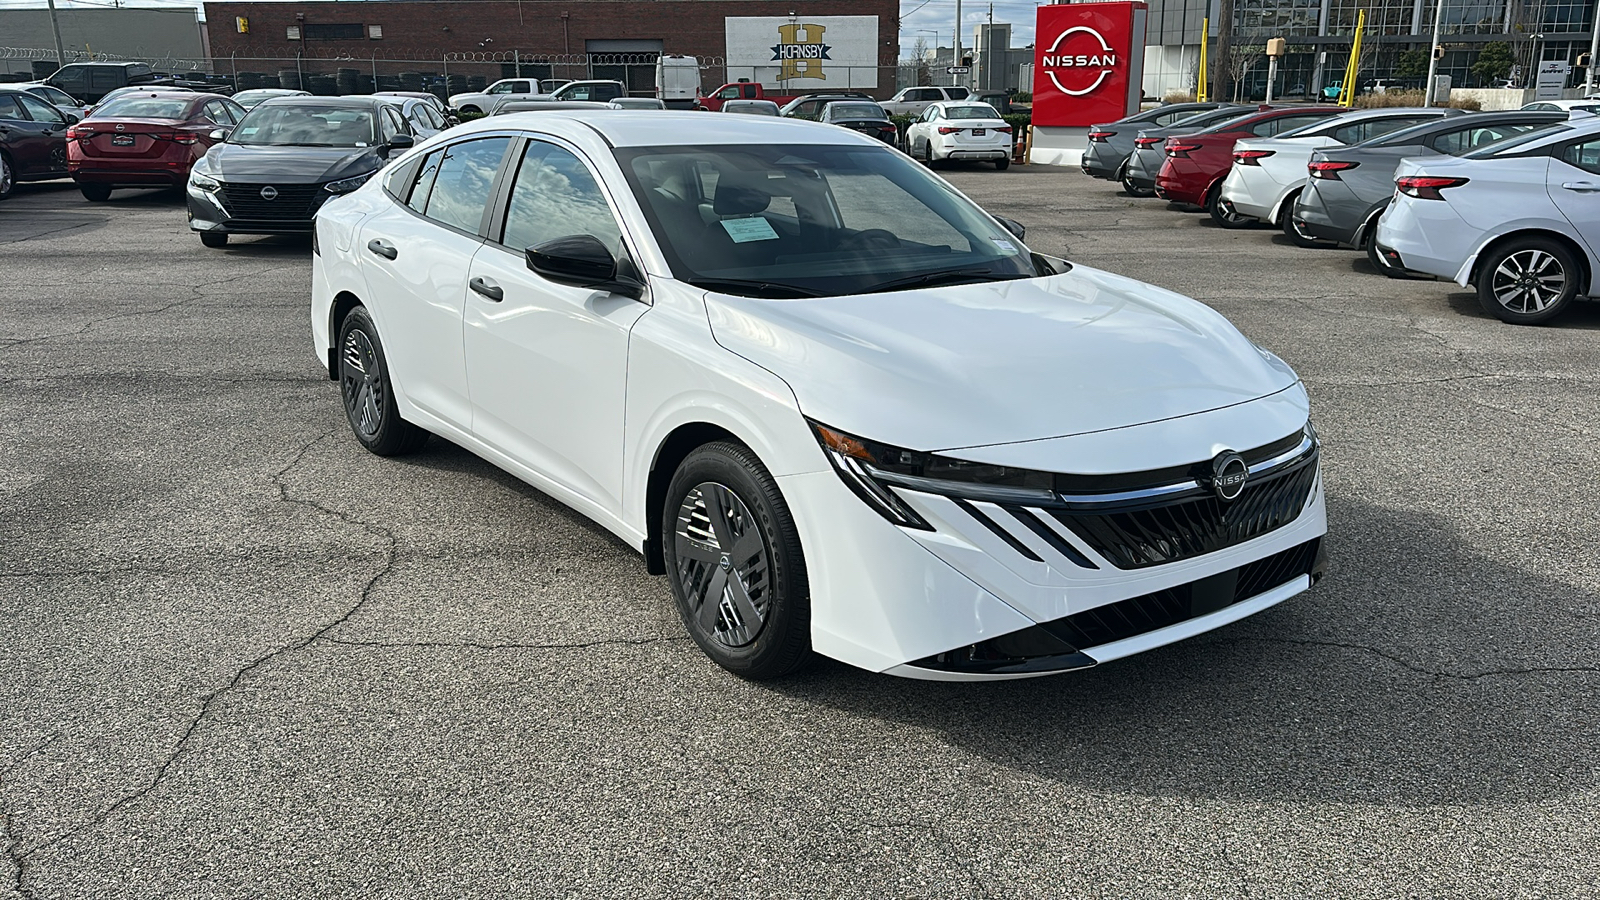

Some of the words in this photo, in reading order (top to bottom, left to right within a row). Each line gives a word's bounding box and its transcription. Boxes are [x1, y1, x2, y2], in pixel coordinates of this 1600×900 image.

[776, 23, 826, 81] H
[779, 44, 824, 58] HORNSBY
[1042, 54, 1115, 67] NISSAN
[1214, 472, 1249, 486] NISSAN
